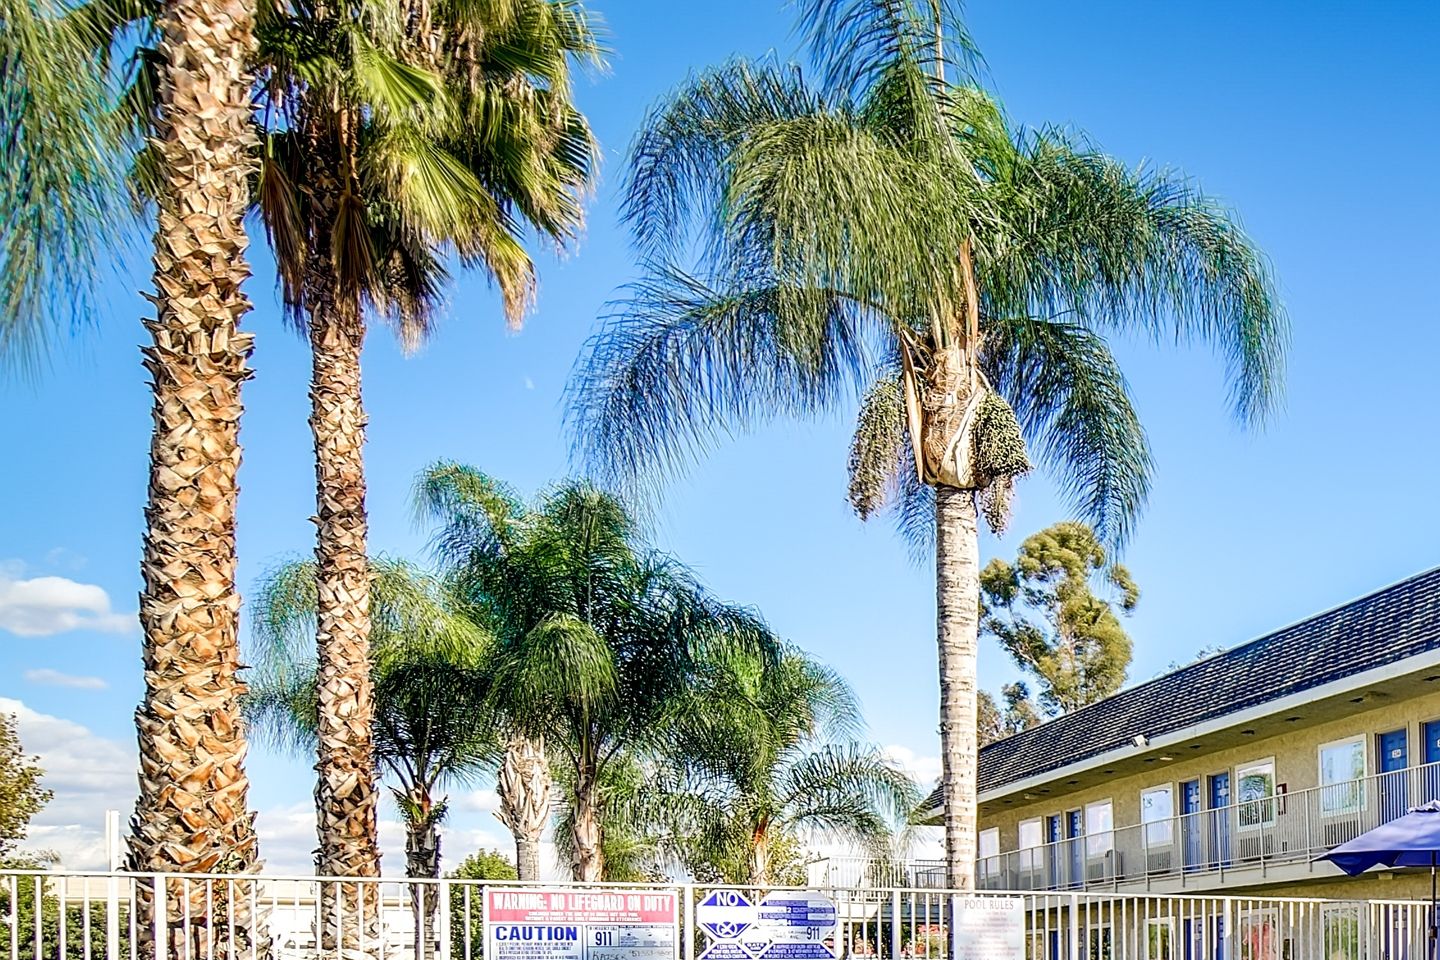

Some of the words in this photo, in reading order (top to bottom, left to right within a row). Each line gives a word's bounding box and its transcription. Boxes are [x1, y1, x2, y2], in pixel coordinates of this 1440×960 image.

[493, 892, 548, 910] WARNING:
[551, 893, 565, 911] NO
[568, 893, 624, 911] LIFEGUARD
[627, 894, 641, 911] ON
[644, 895, 671, 912] DUTY
[716, 891, 739, 907] NO
[964, 899, 987, 910] POOL
[989, 900, 1014, 910] RULES
[495, 926, 578, 941] CAUTION
[595, 931, 612, 946] 911
[806, 926, 820, 940] 911
